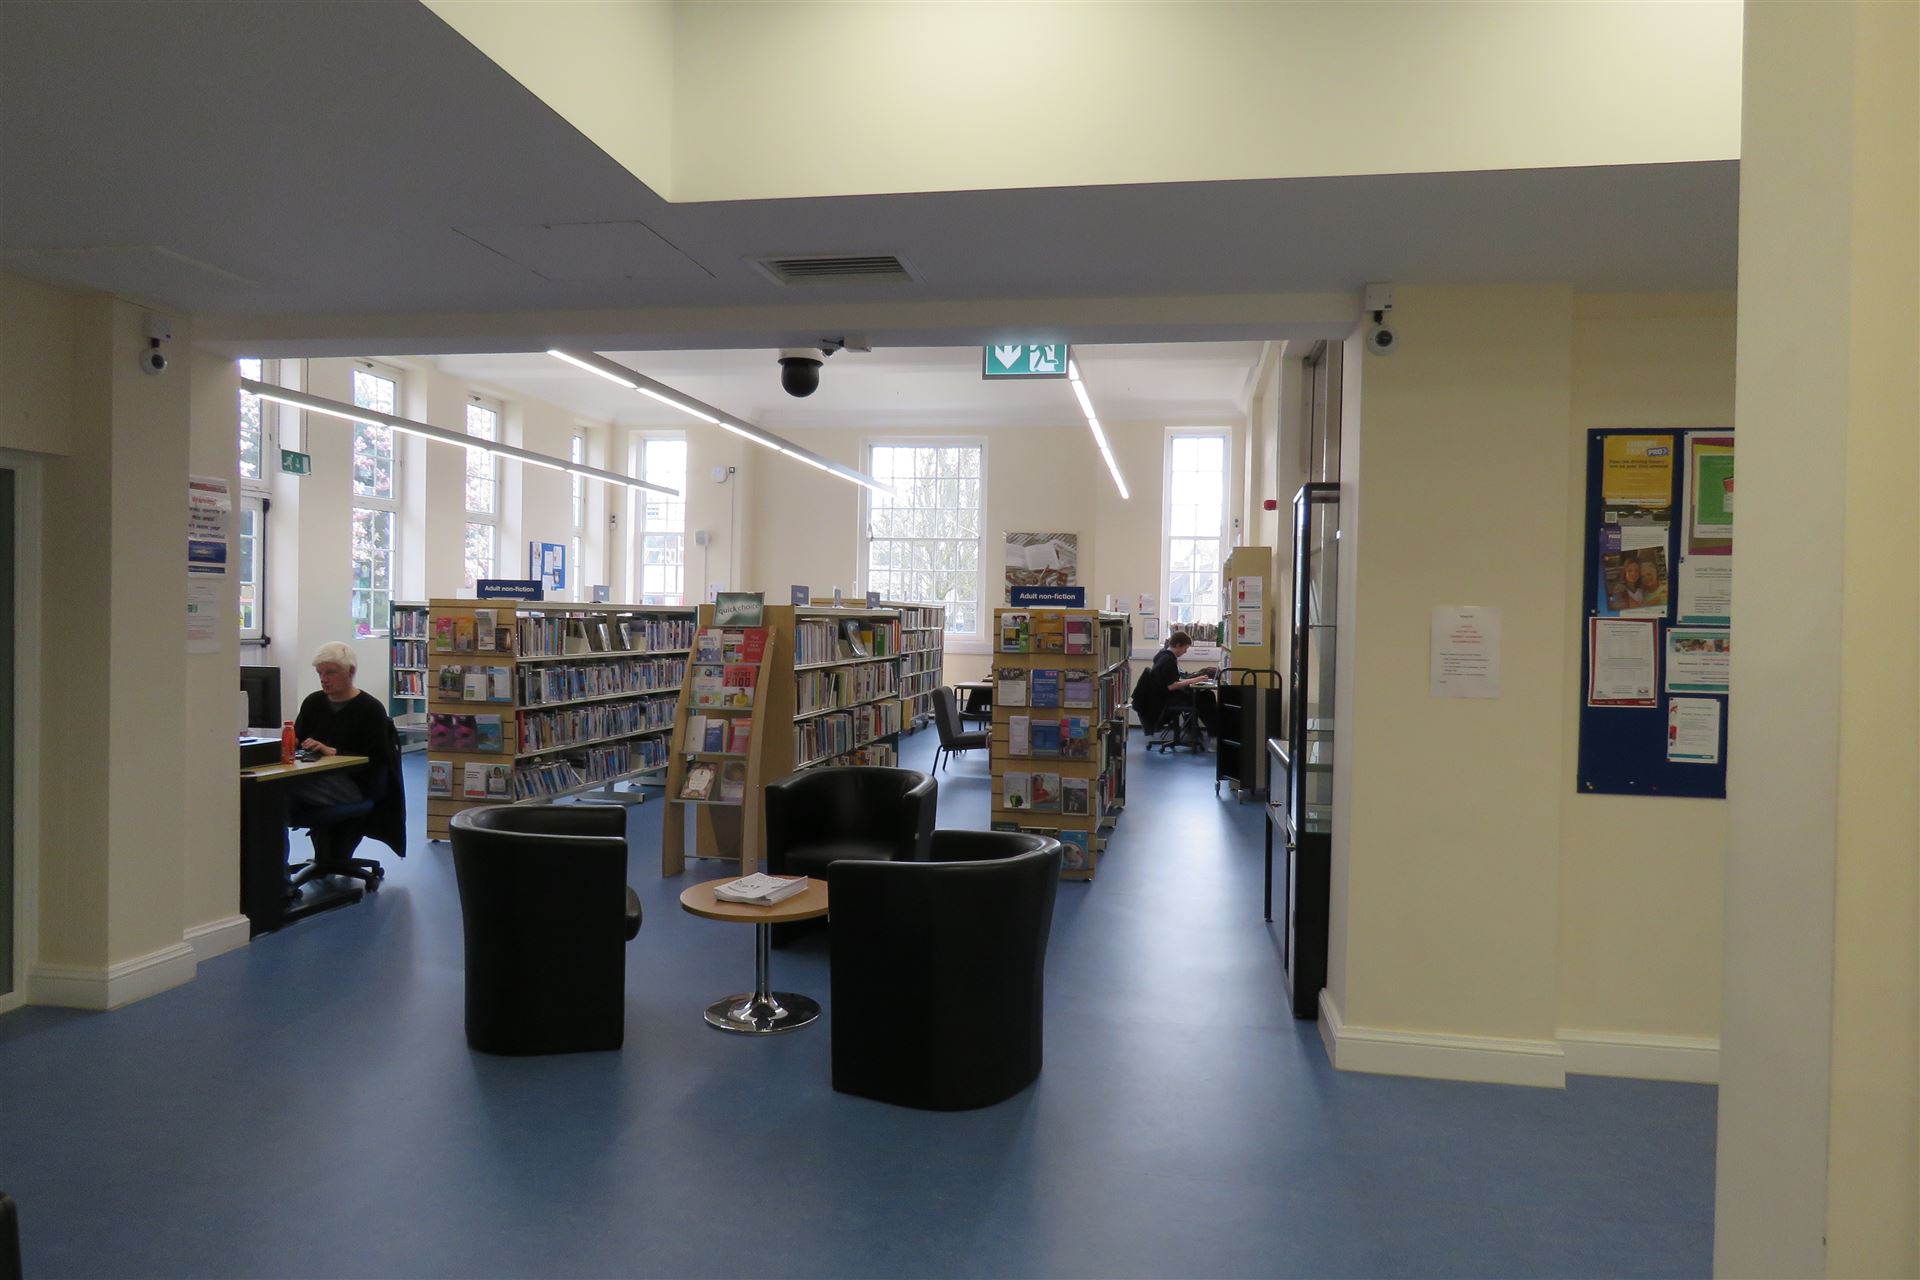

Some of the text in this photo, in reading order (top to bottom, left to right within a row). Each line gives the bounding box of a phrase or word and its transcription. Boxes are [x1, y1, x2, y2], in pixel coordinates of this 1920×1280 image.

[1019, 592, 1076, 600] Adult non-fiction
[719, 606, 737, 615] quick
